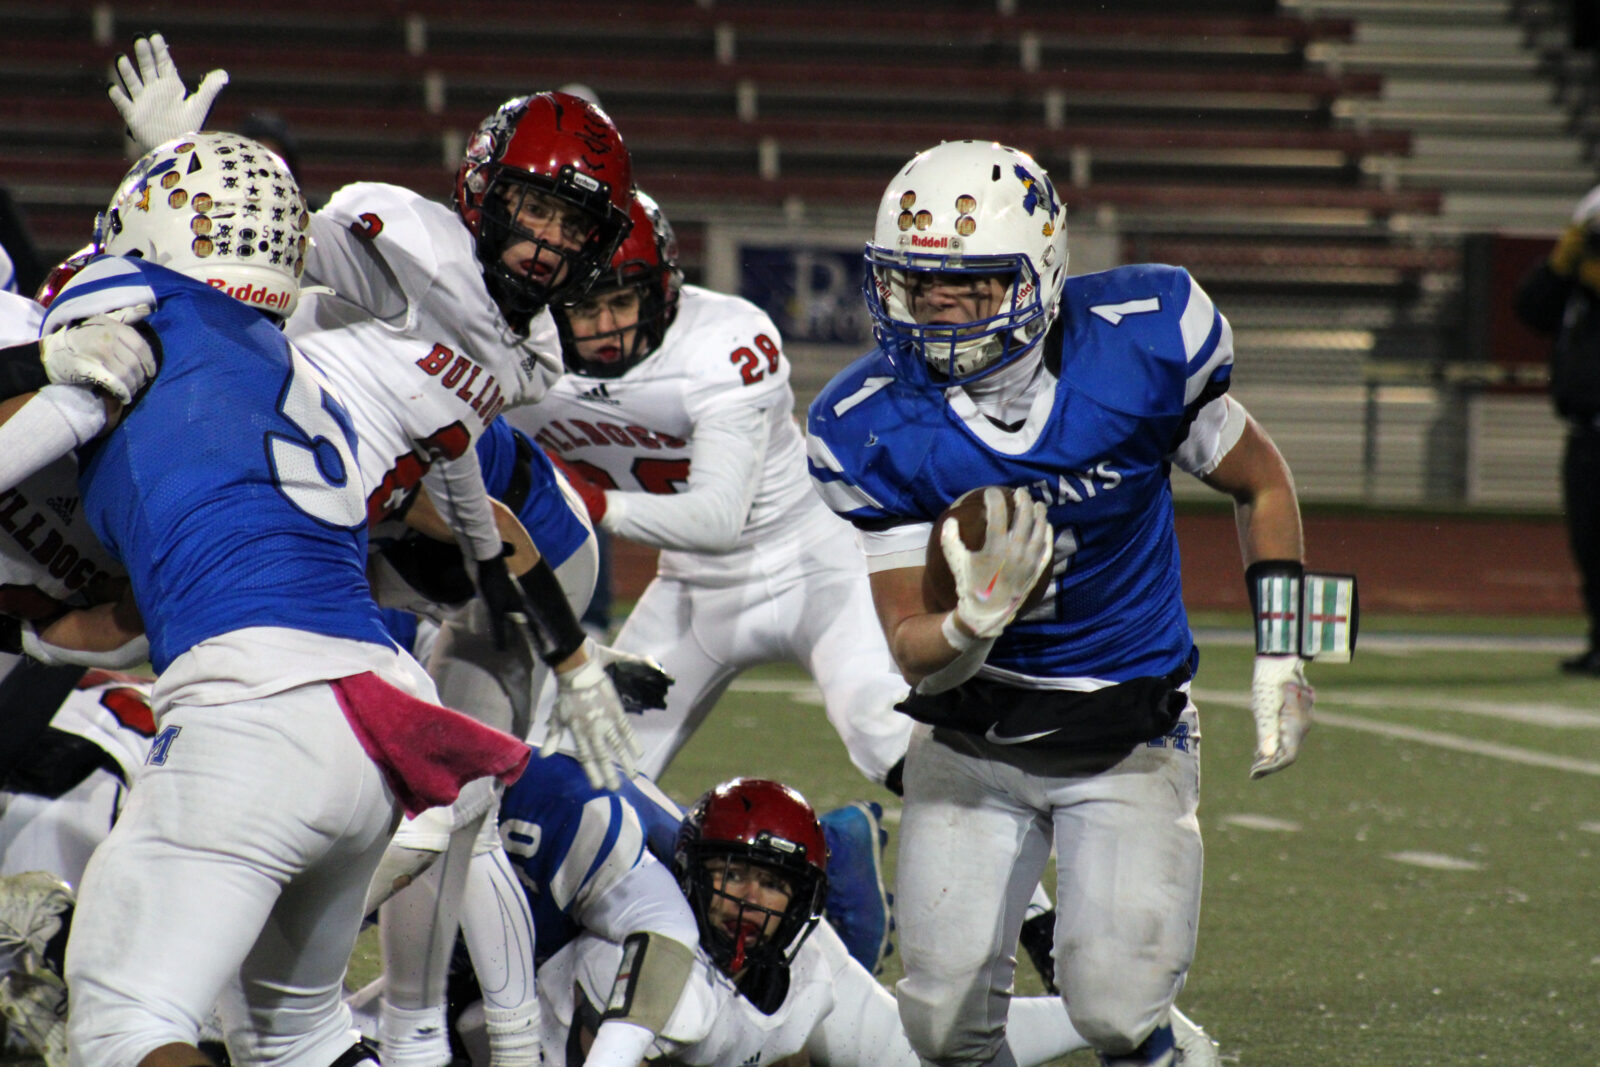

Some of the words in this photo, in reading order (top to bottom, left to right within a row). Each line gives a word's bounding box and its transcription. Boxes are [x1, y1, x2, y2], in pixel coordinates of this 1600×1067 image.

[911, 235, 948, 248] Riddell
[1088, 296, 1161, 326] 1
[730, 334, 779, 386] 28
[831, 376, 896, 418] 1
[264, 338, 370, 530] 5
